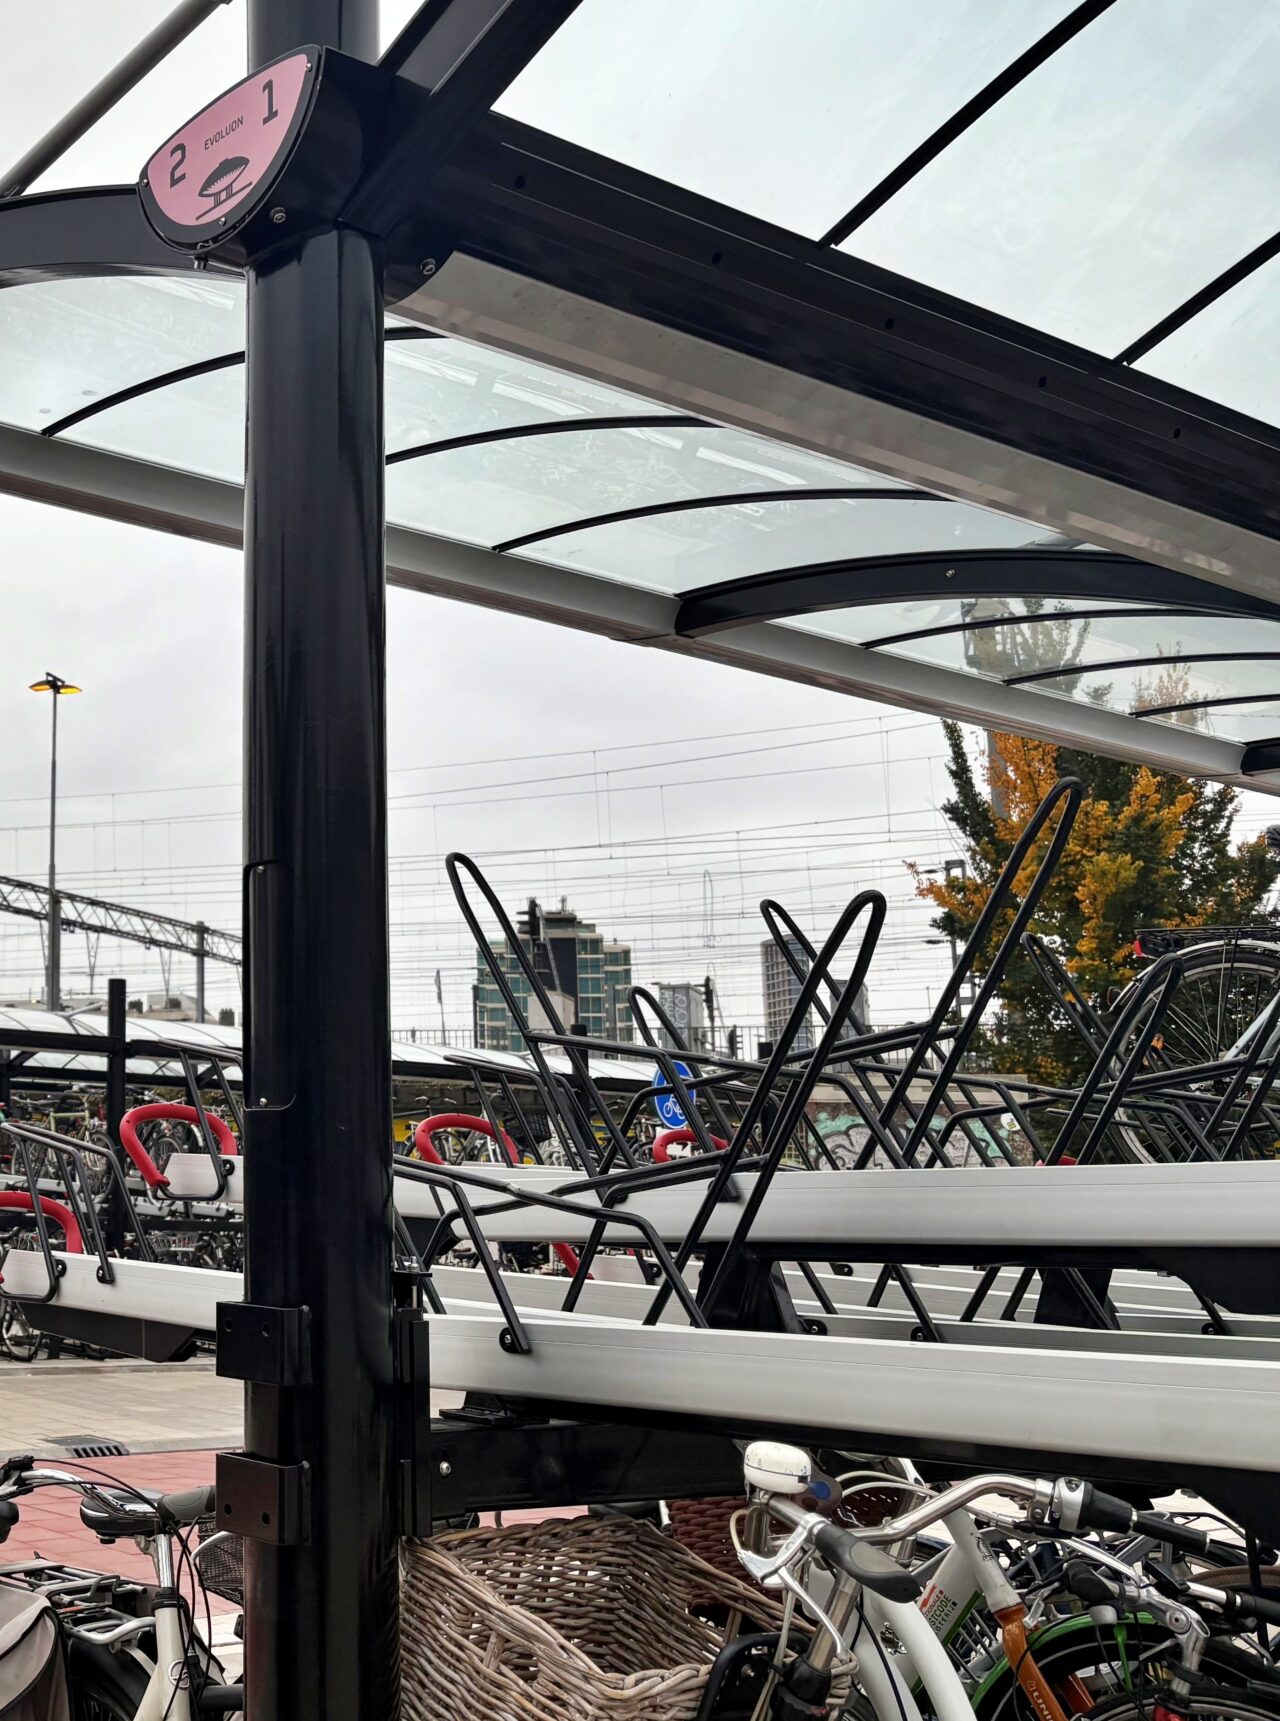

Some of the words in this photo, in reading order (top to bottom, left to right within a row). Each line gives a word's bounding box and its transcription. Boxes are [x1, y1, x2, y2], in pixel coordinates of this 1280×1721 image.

[169, 142, 186, 189] 2
[204, 115, 244, 151] EVOLUON
[262, 78, 279, 126] 1
[928, 1594, 952, 1627] STCODE
[935, 1605, 955, 1632] OTERIJ
[1033, 1691, 1054, 1721] UNI
